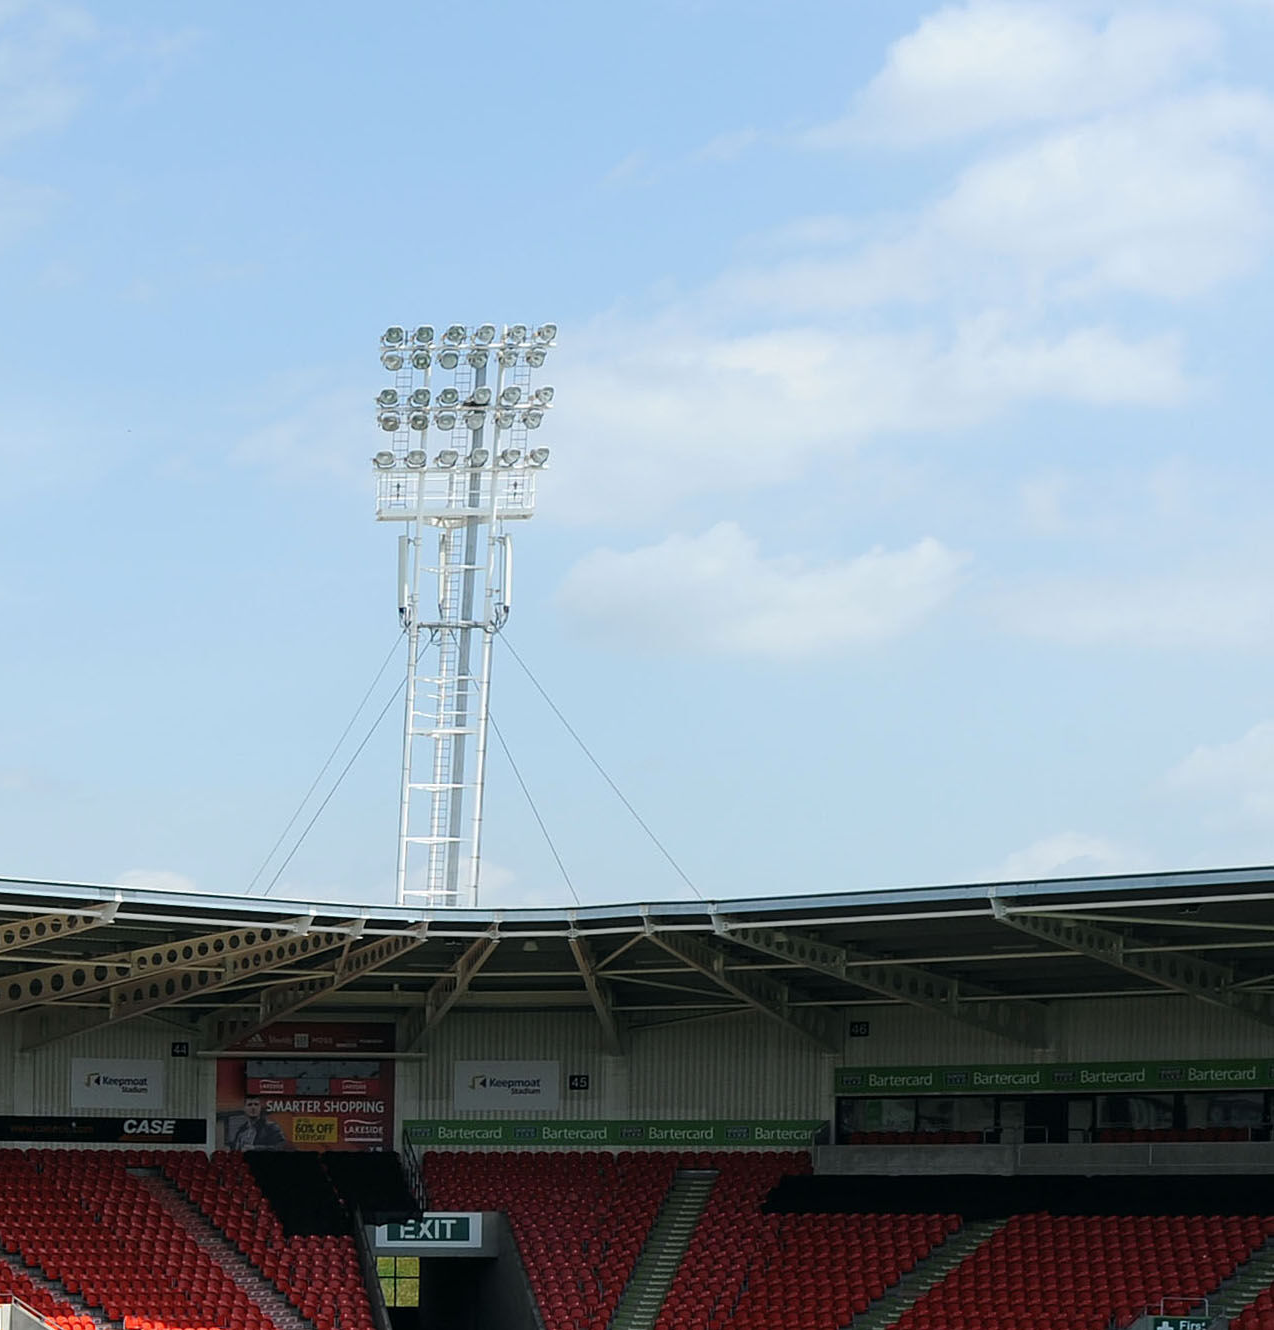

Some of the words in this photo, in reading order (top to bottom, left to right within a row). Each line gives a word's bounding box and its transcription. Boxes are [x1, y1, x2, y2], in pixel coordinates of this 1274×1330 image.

[853, 1023, 868, 1034] 46
[173, 1045, 188, 1055] 44
[868, 1072, 933, 1087] Bartercard
[972, 1071, 1040, 1086] Bartercard
[1080, 1068, 1146, 1084] Bartercard
[1188, 1066, 1257, 1081] Bartercard
[102, 1075, 149, 1090] Keepmoat
[489, 1078, 540, 1093] Keepmoat
[571, 1077, 588, 1088] 45
[266, 1101, 321, 1113] SMARTER
[324, 1101, 385, 1114] SHOPPING
[123, 1119, 176, 1135] CASE
[344, 1125, 384, 1135] LAKESIDE
[438, 1127, 502, 1139] Bartercard
[542, 1127, 607, 1140] Bartercard
[649, 1128, 714, 1140] Bartercard
[755, 1128, 813, 1140] Bartercar
[400, 1219, 457, 1239] EXIT
